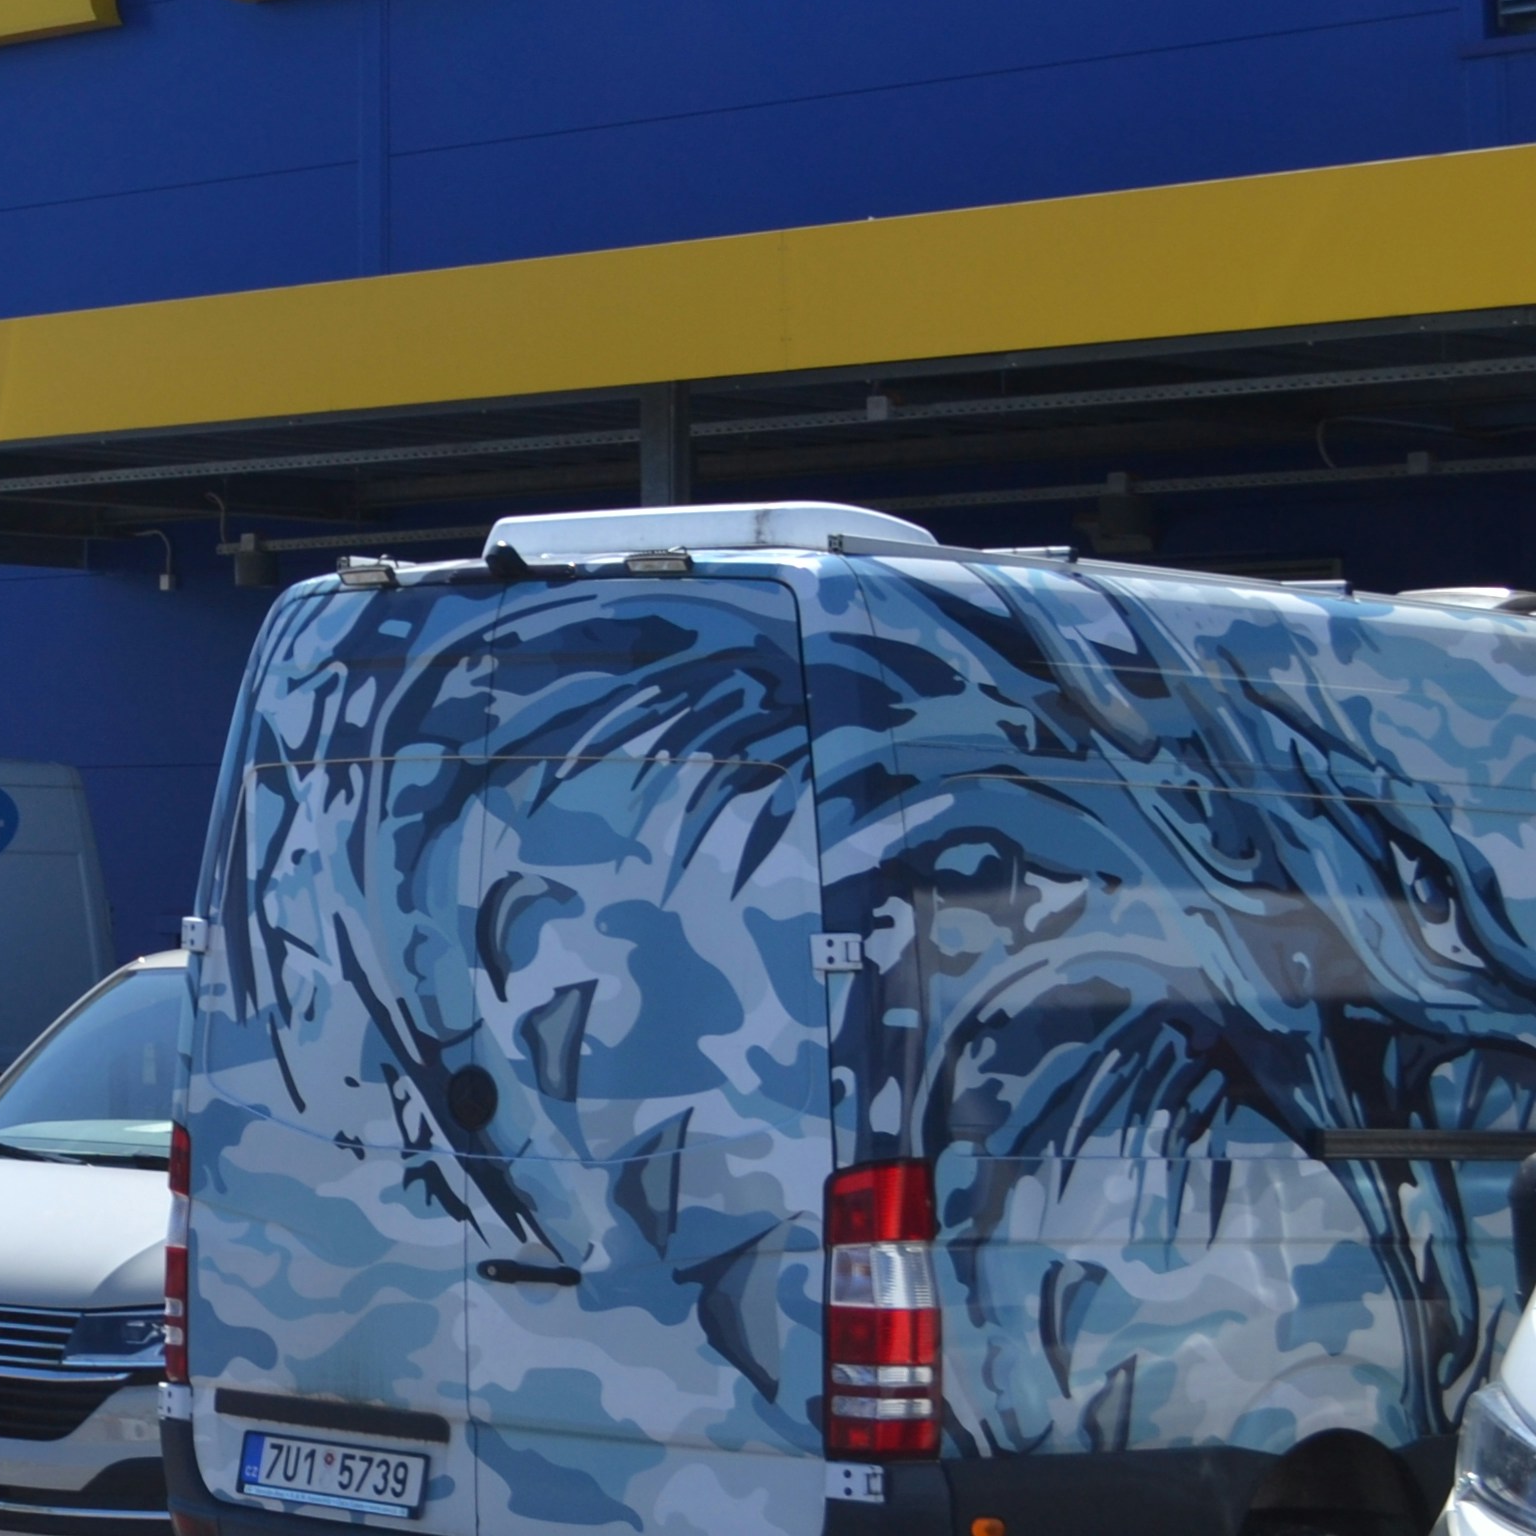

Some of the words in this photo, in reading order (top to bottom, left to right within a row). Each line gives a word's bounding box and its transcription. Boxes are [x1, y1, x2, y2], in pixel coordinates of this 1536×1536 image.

[245, 1465, 258, 1477] CZ
[266, 1442, 316, 1486] 7U1
[338, 1453, 408, 1498] 5739
